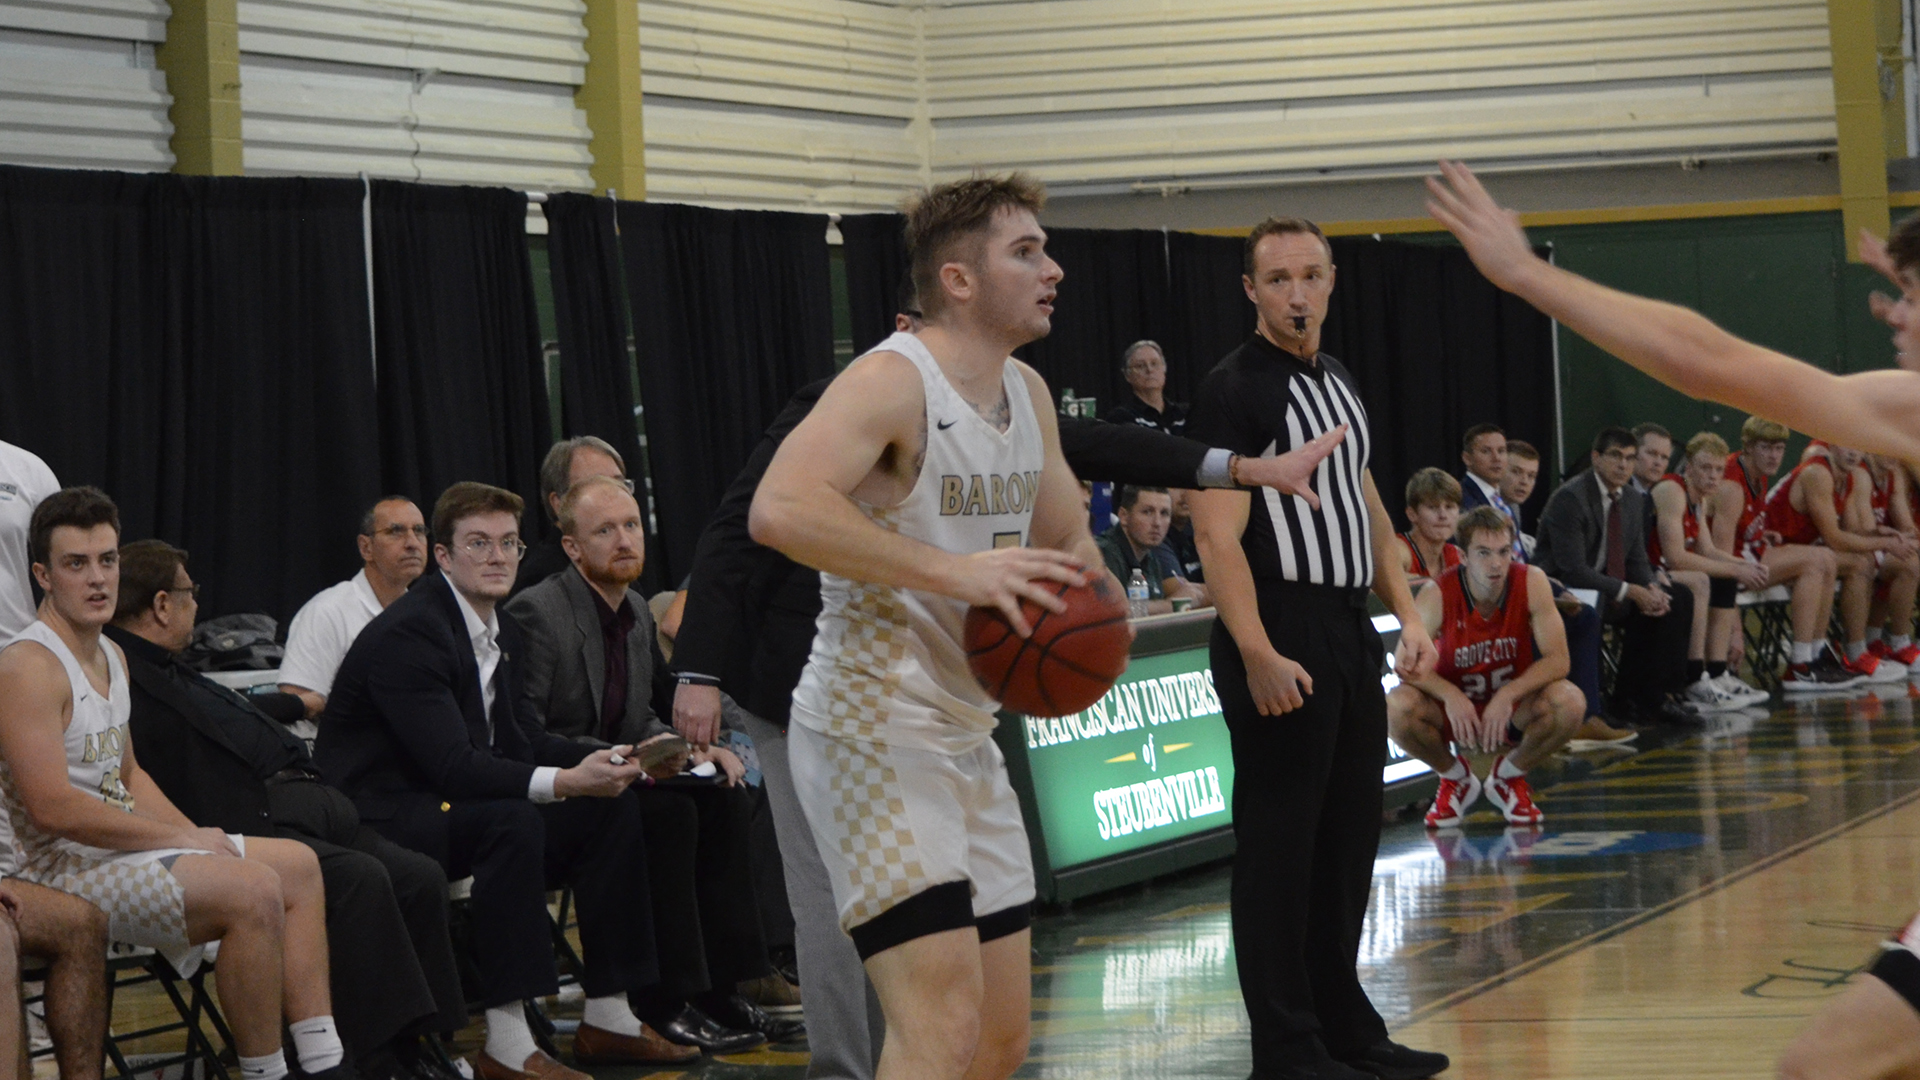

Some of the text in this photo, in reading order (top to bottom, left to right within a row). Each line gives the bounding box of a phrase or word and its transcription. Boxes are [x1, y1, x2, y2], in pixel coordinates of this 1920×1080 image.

[1454, 636, 1517, 668] GROVE CITY
[1025, 668, 1223, 749] FRANCISCAN UNIVERS
[1142, 732, 1156, 772] of
[1093, 766, 1225, 841] STEUBENVILLE
